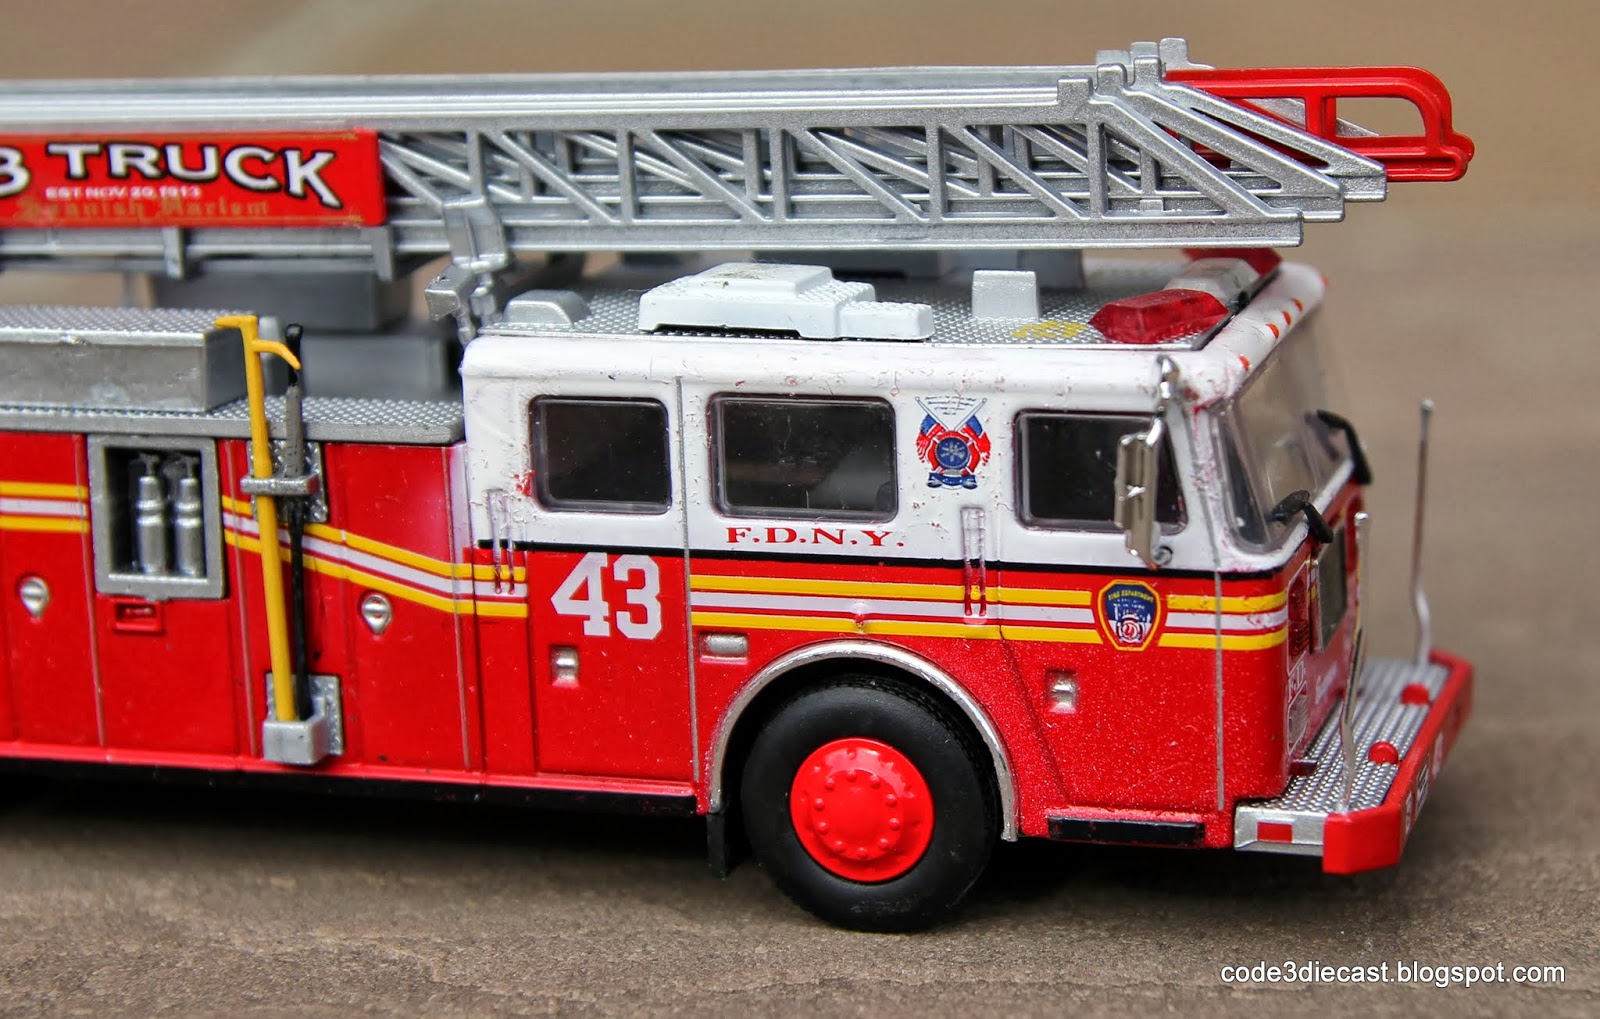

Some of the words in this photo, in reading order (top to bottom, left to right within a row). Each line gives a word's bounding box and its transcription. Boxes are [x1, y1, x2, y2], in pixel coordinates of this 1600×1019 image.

[47, 143, 343, 210] TRUCK
[726, 527, 905, 547] F.D.N.Y.
[550, 552, 662, 640] 43
